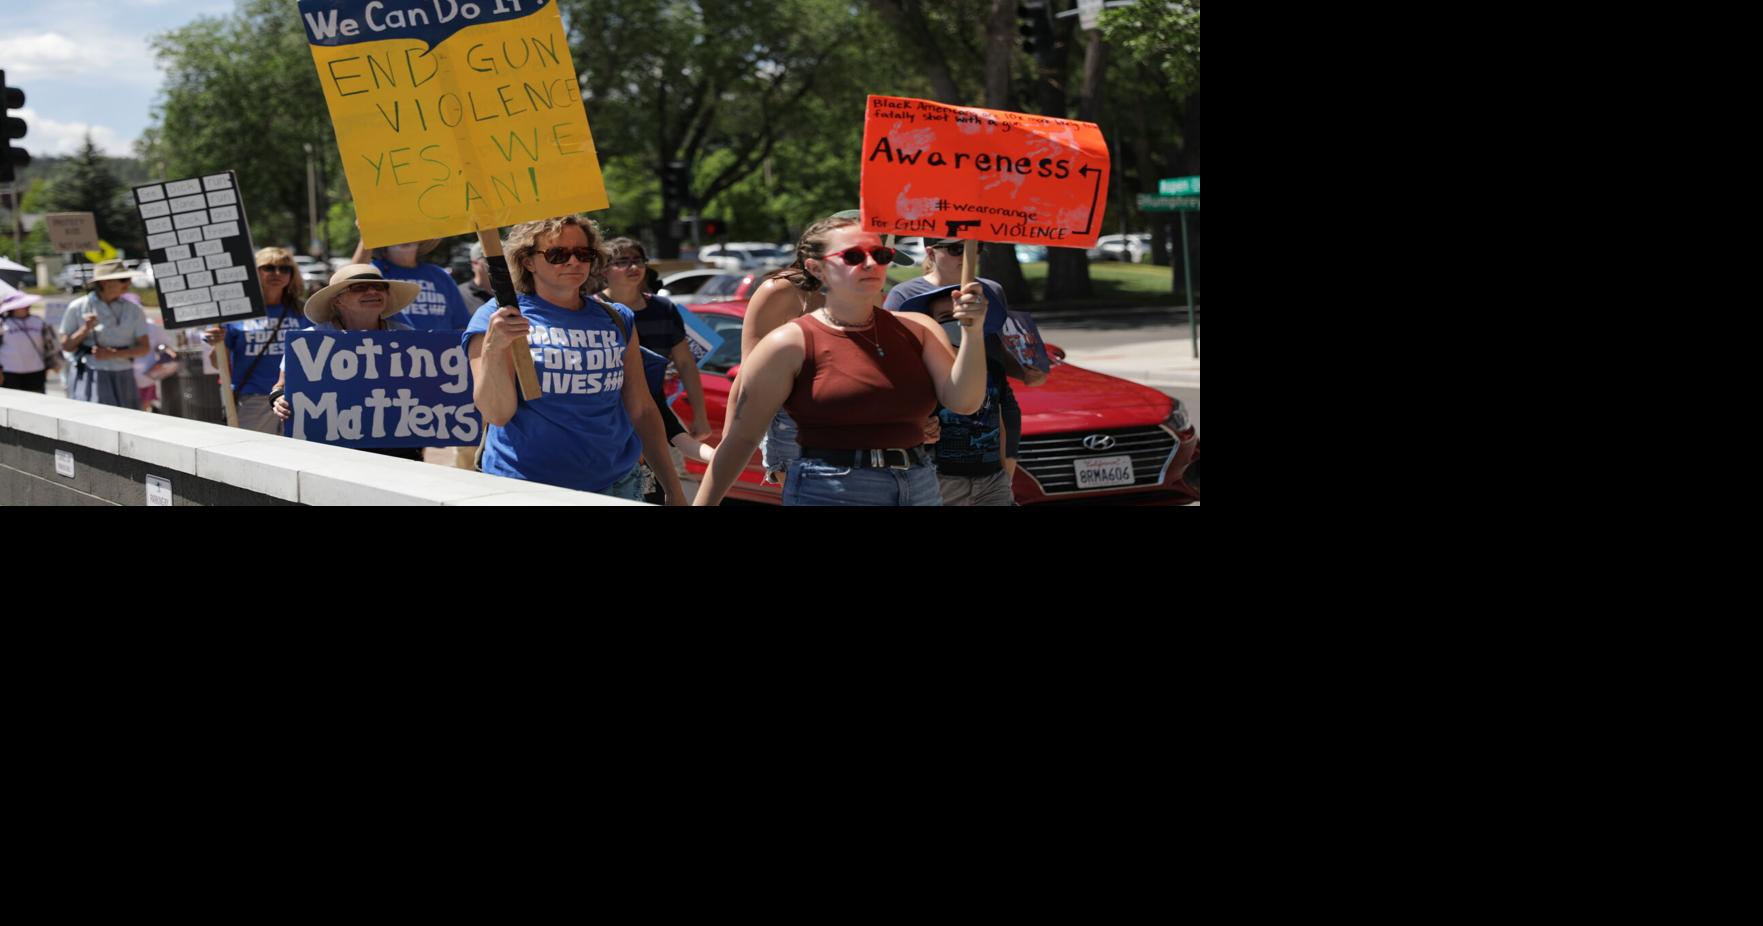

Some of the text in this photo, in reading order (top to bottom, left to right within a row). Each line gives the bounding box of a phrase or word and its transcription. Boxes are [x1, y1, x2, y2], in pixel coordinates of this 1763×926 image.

[305, 10, 360, 40] We
[365, 1, 429, 32] Can
[433, 0, 480, 23] Do
[328, 33, 560, 96] END GUN
[376, 78, 578, 133] VIOLENCE
[873, 99, 912, 109] Black
[875, 110, 915, 123] fatally
[923, 113, 948, 121] shot
[955, 114, 982, 125] with
[490, 122, 584, 163] WE
[869, 137, 1069, 179] Awareness
[417, 167, 540, 219] CAN!
[895, 217, 936, 231] GUN
[990, 222, 1069, 240] VIOLENCE
[527, 325, 619, 348] MARCH
[291, 336, 468, 393] Voting
[529, 348, 582, 371] FOR
[542, 372, 602, 394] IVES
[292, 389, 479, 442] Matters
[1080, 466, 1130, 483] 8RMA606
